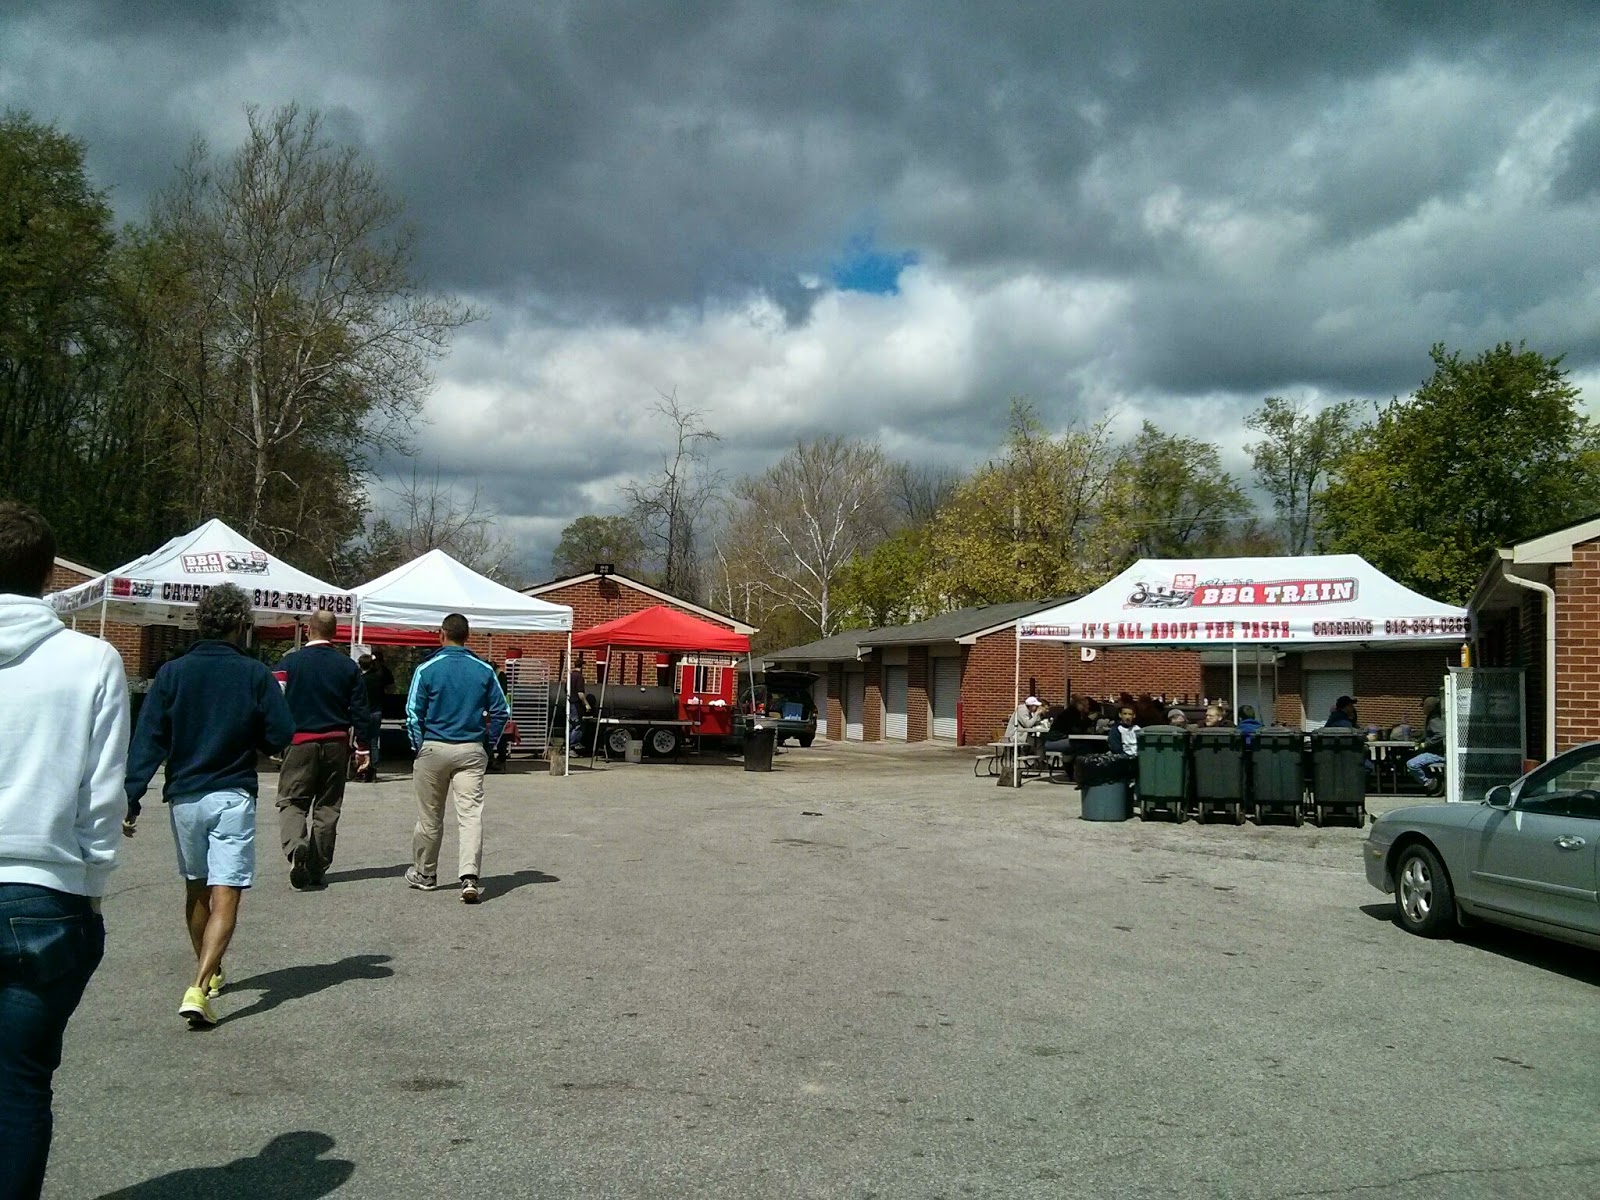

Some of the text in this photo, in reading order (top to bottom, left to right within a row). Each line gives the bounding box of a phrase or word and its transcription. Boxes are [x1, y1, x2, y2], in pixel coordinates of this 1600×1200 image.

[185, 554, 220, 566] BBQ
[187, 563, 222, 573] TRAIN
[253, 588, 352, 614] 812-334-0266
[1201, 587, 1256, 605] BBQ
[1263, 582, 1353, 603] TRAIN
[1081, 623, 1110, 639] IT'S
[1116, 622, 1144, 639] ALL
[1150, 622, 1198, 639] ABOUT
[1205, 621, 1235, 639] THE
[1241, 620, 1296, 639] TASTE.
[1312, 619, 1374, 636] CATERING
[1081, 646, 1097, 662] D
